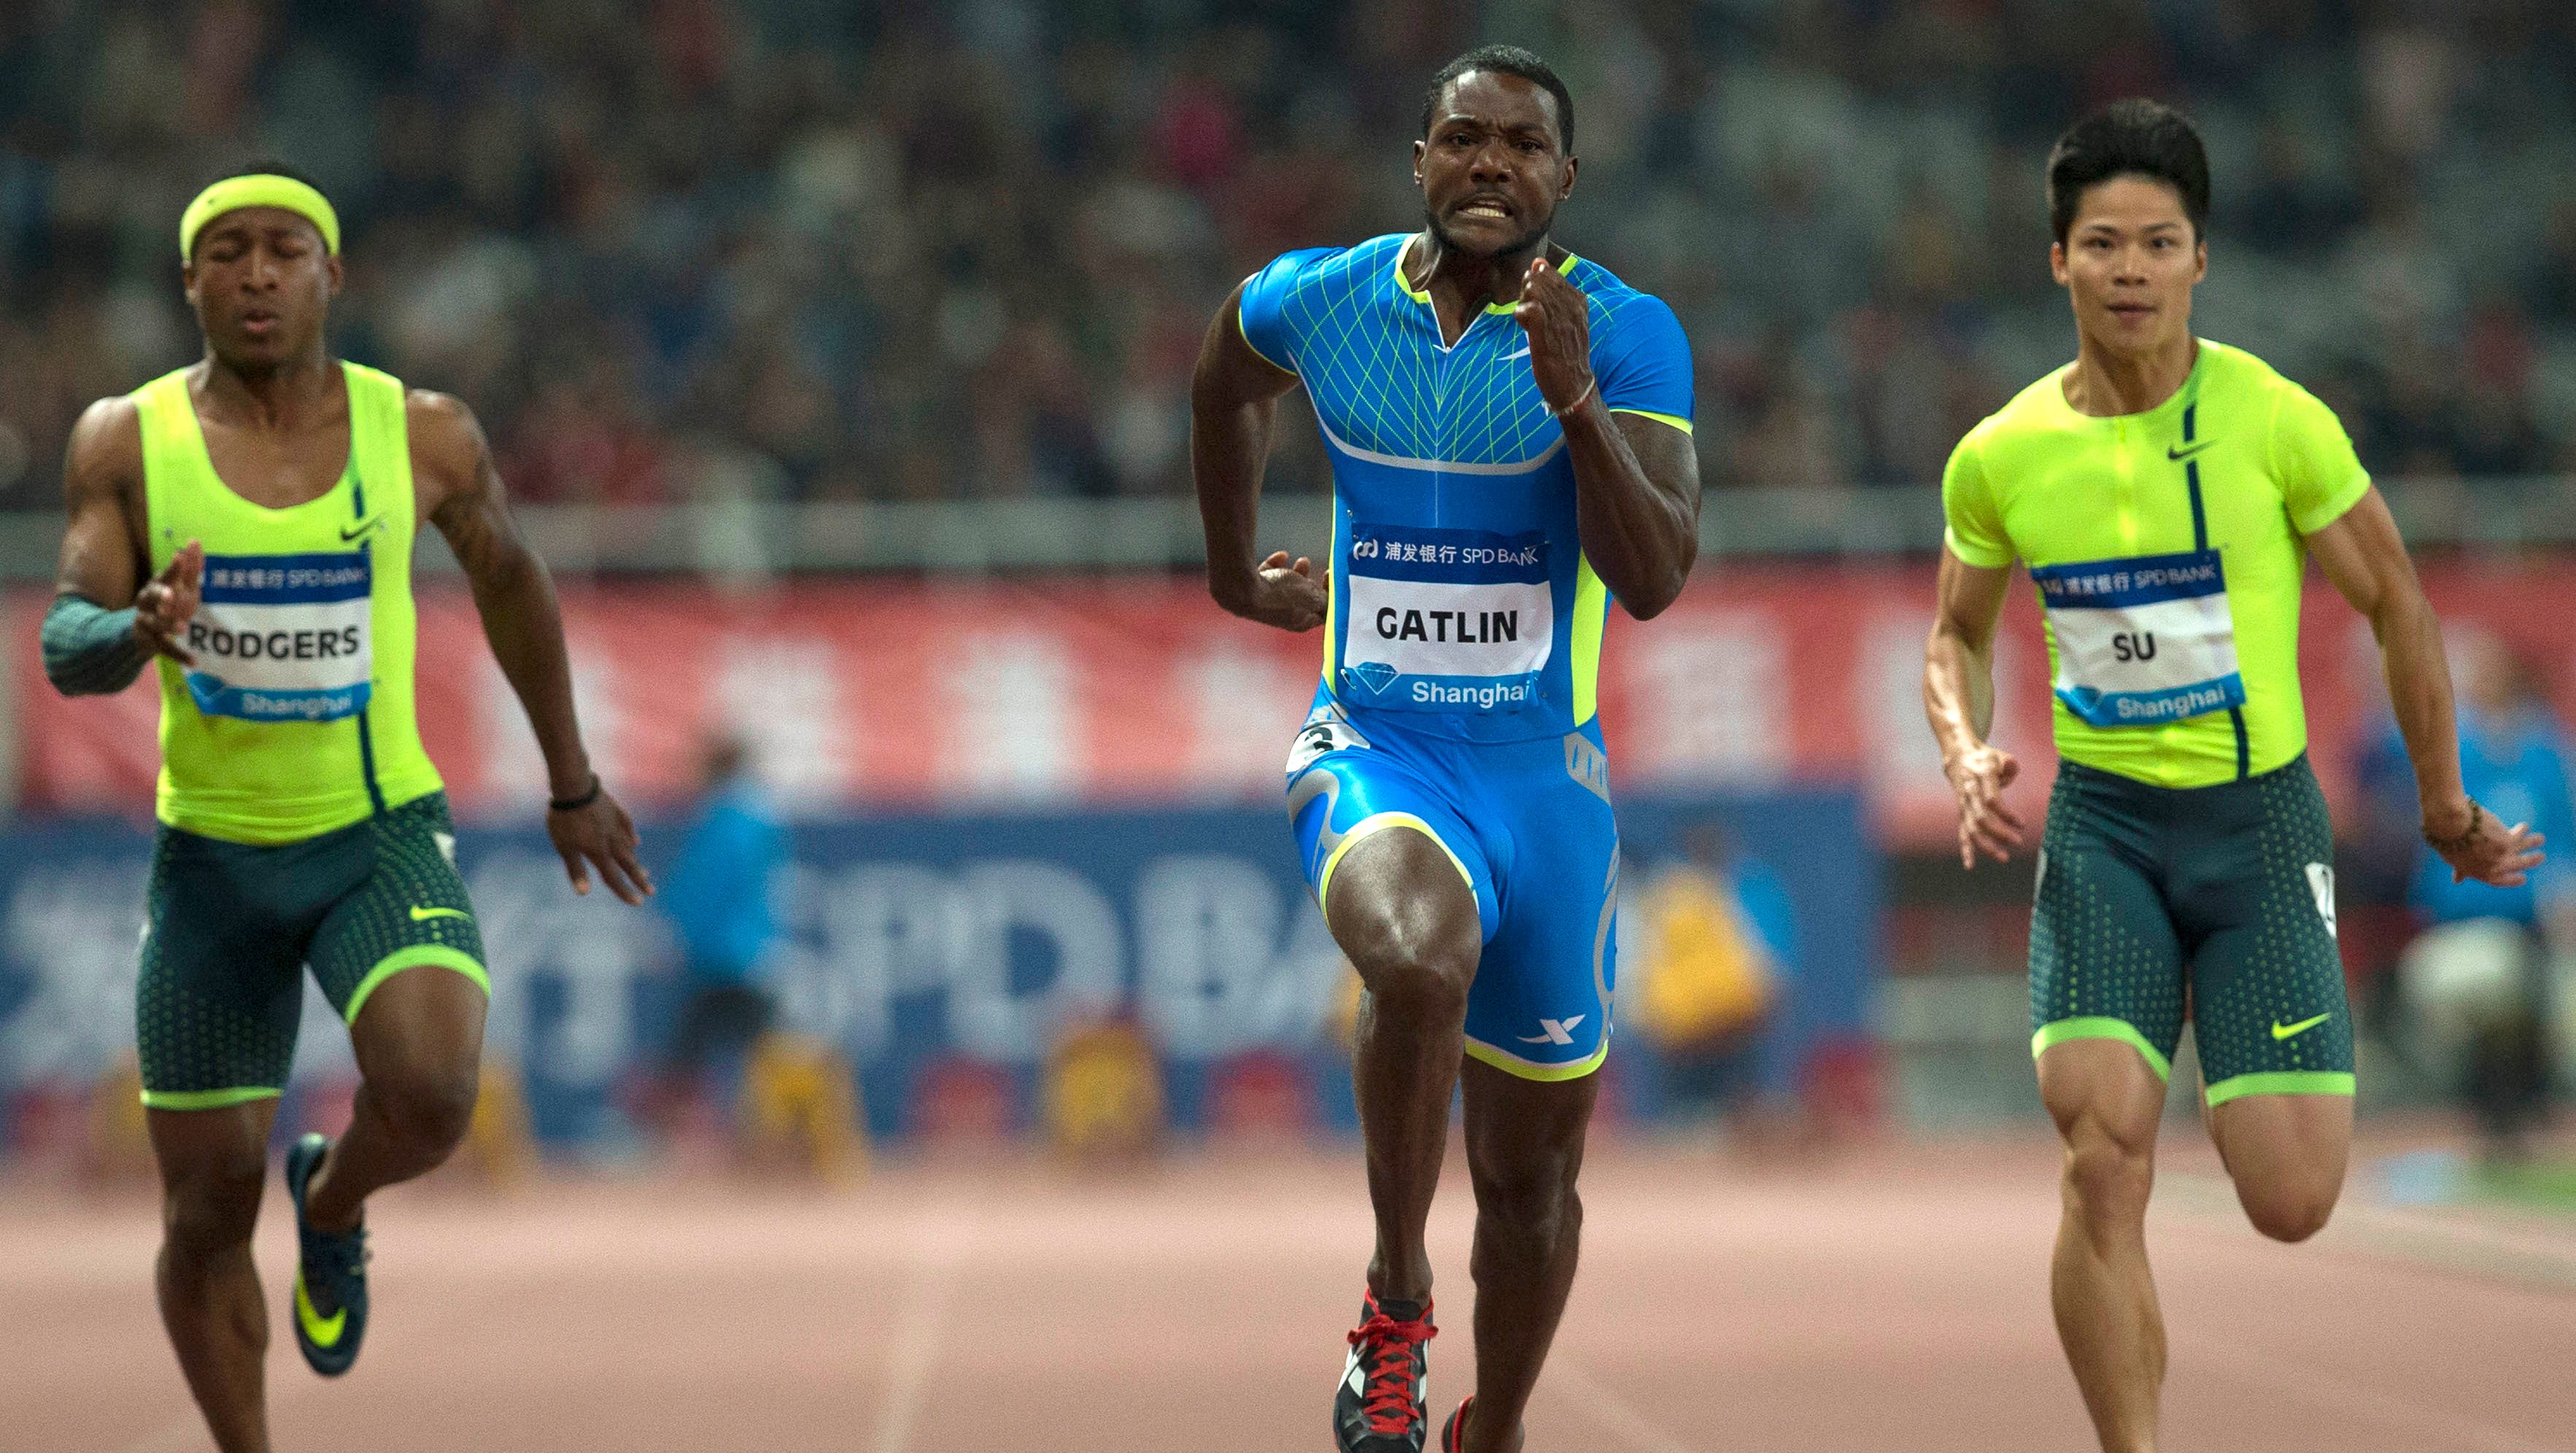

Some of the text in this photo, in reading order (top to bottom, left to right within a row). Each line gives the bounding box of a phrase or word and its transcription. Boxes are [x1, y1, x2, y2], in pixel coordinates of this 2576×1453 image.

[1385, 541, 1539, 567] 浦发银行 SPD BANK
[2133, 568, 2168, 589] SPD
[2167, 563, 2216, 585] BANK
[1376, 607, 1518, 643] GATLIN
[187, 624, 360, 660] RODGERS
[2113, 632, 2156, 663] SU
[241, 693, 352, 719] Shanghai
[1412, 681, 1531, 710] Shanghai
[2116, 684, 2226, 718] Shanghai
